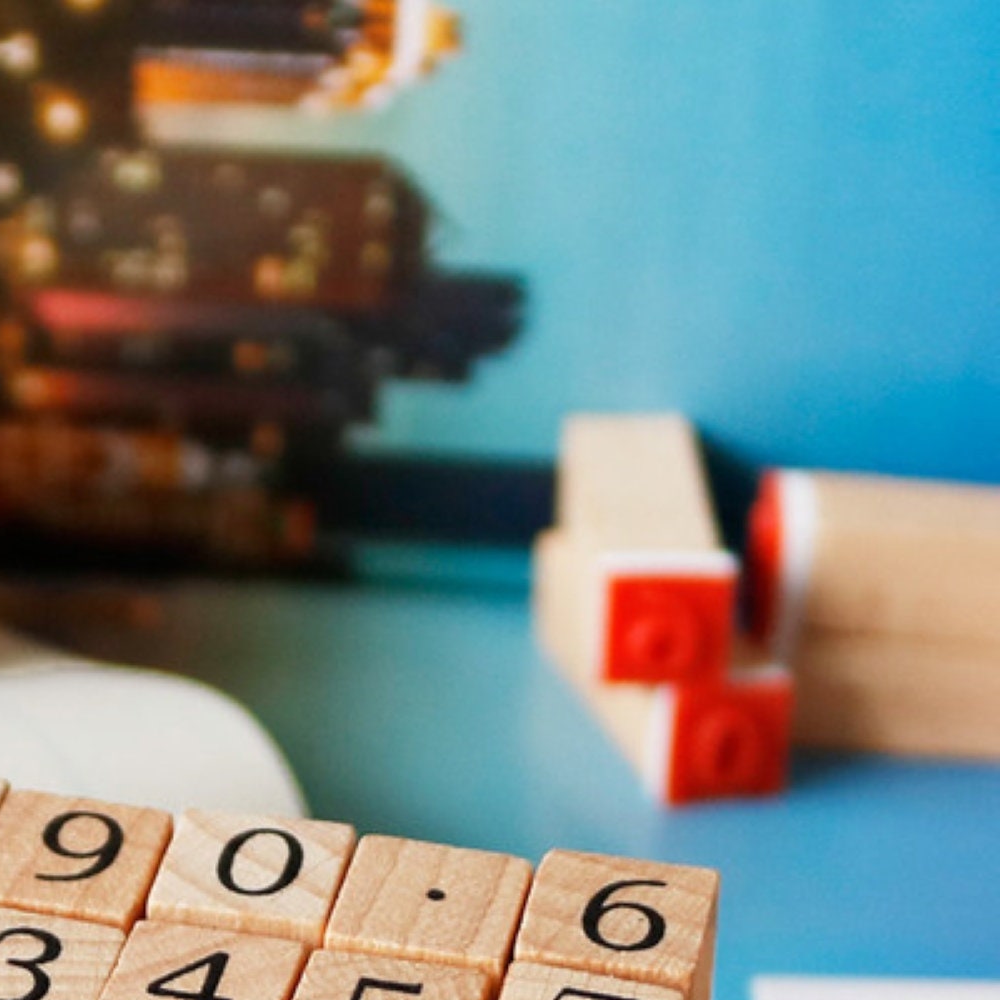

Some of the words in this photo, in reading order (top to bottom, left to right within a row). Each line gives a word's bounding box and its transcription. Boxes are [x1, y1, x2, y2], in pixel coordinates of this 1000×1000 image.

[33, 810, 125, 882] 9
[216, 827, 304, 897] 0
[580, 879, 668, 952] 6
